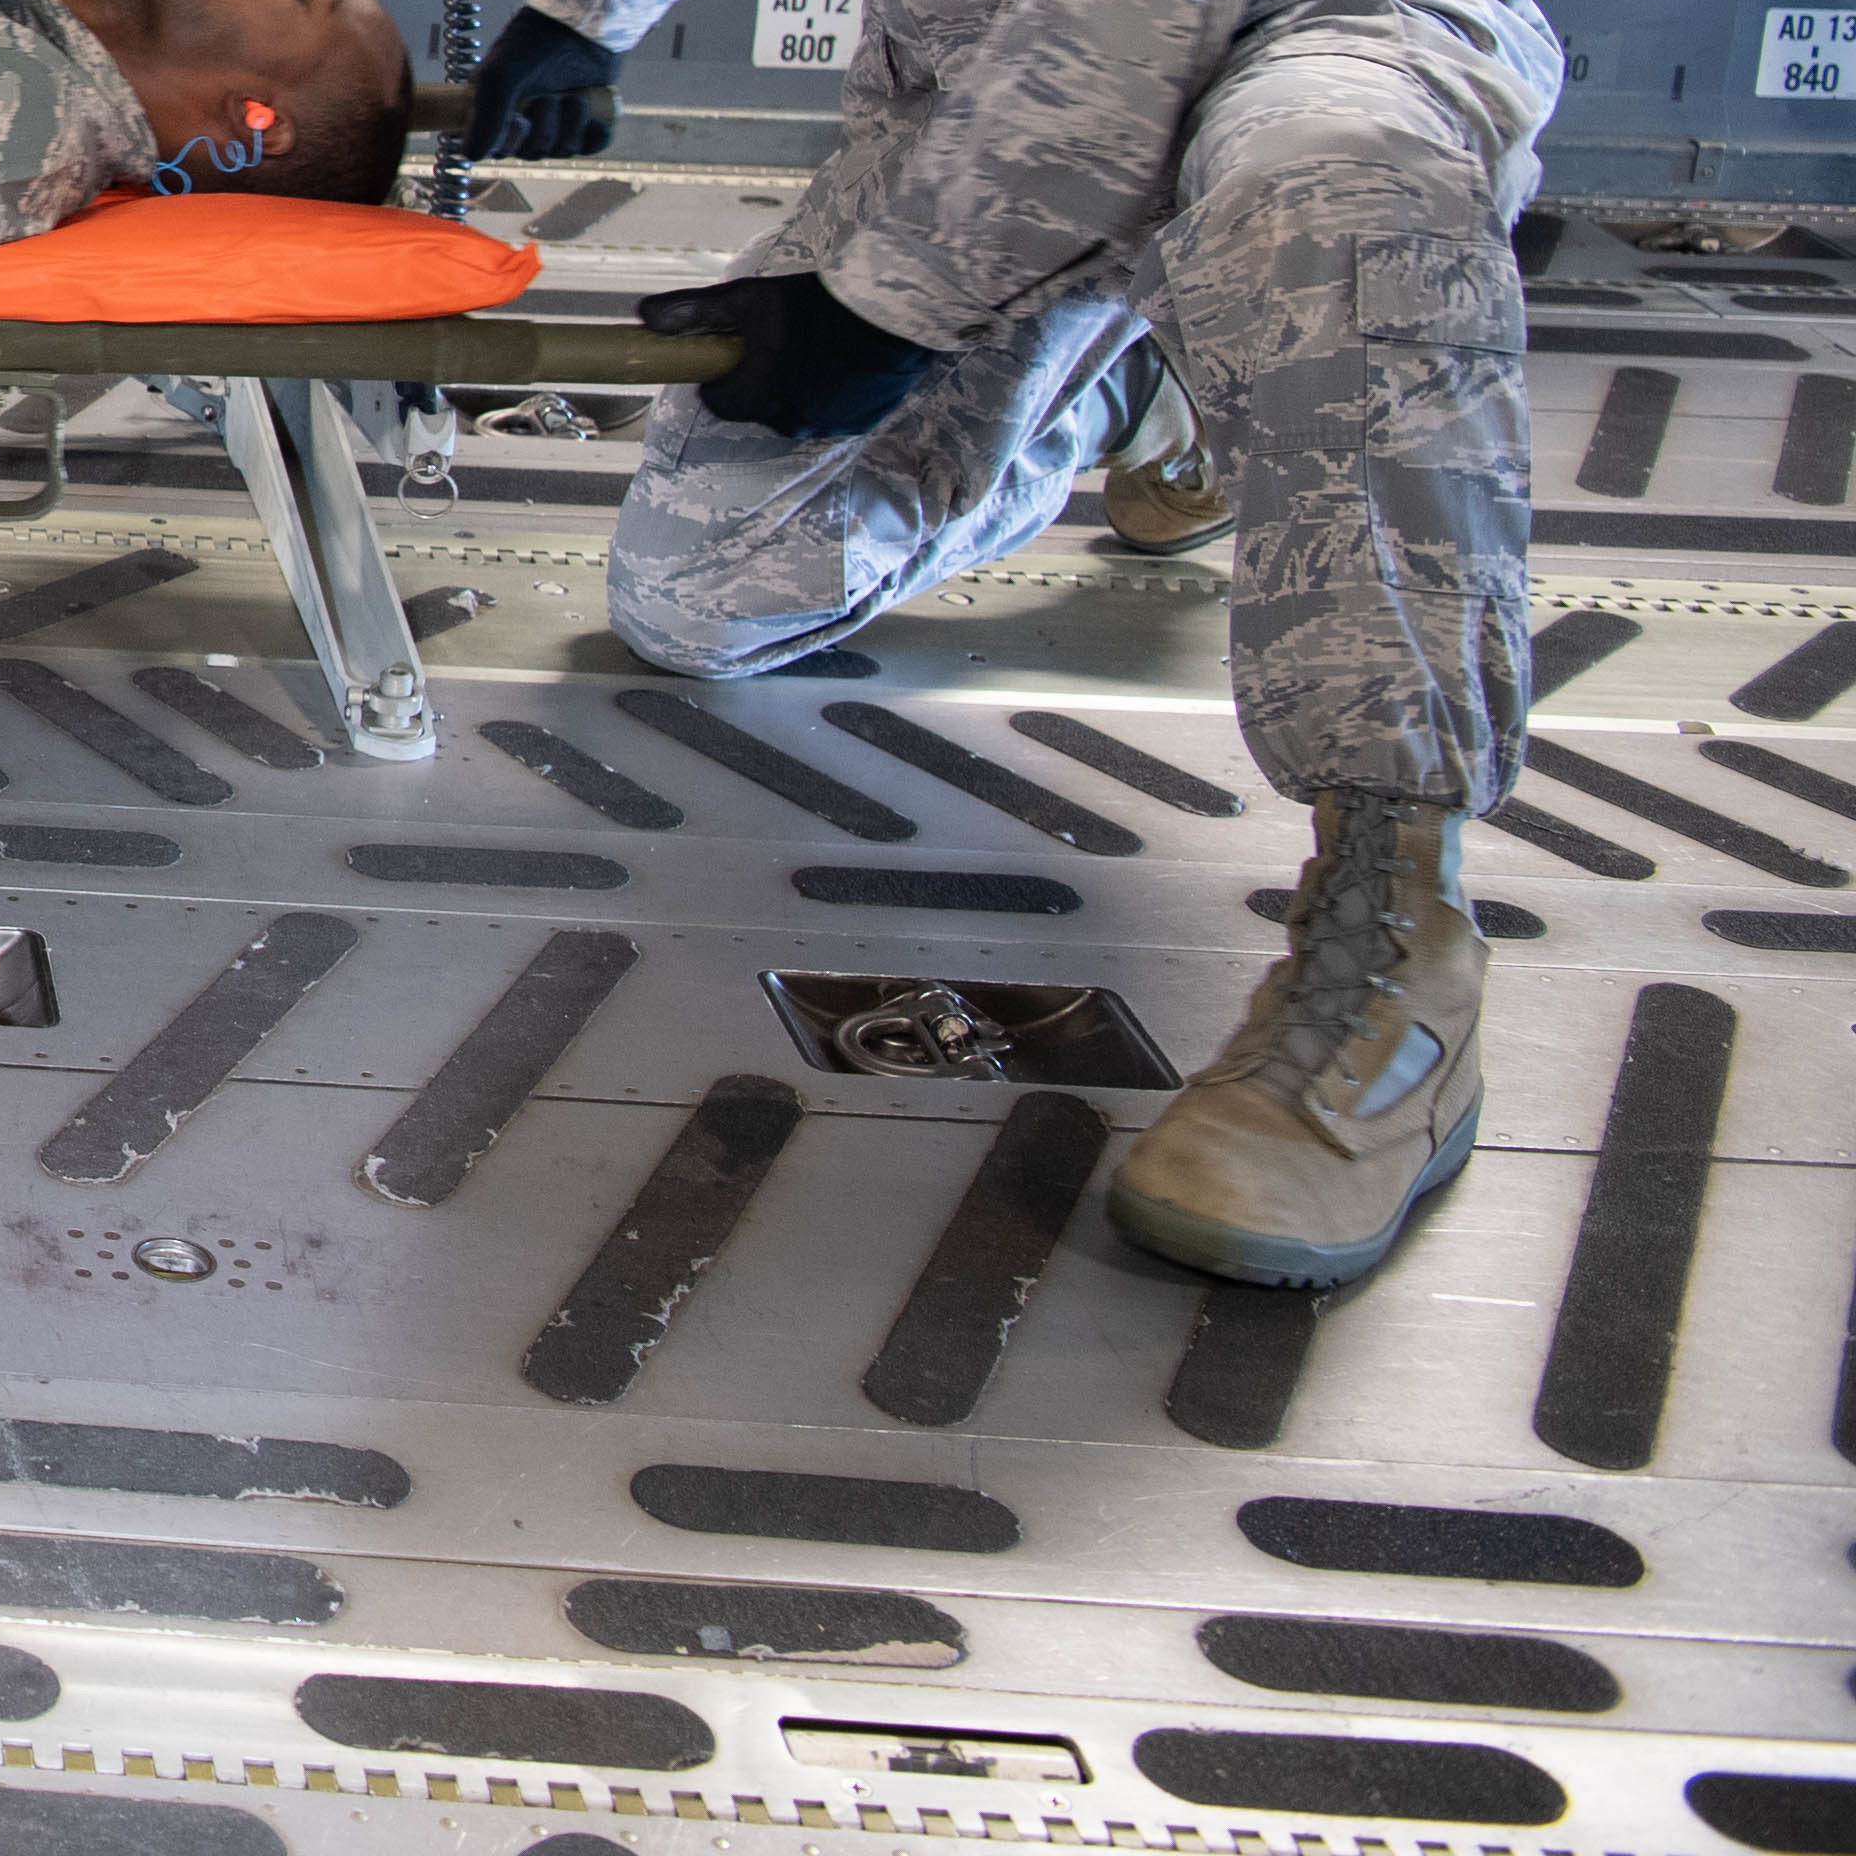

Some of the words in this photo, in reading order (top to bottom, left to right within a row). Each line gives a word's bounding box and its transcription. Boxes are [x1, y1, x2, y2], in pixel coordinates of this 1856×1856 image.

[1778, 15, 1815, 41] AD
[1829, 16, 1856, 42] 13
[780, 34, 836, 62] 800
[1784, 63, 1840, 92] 840
